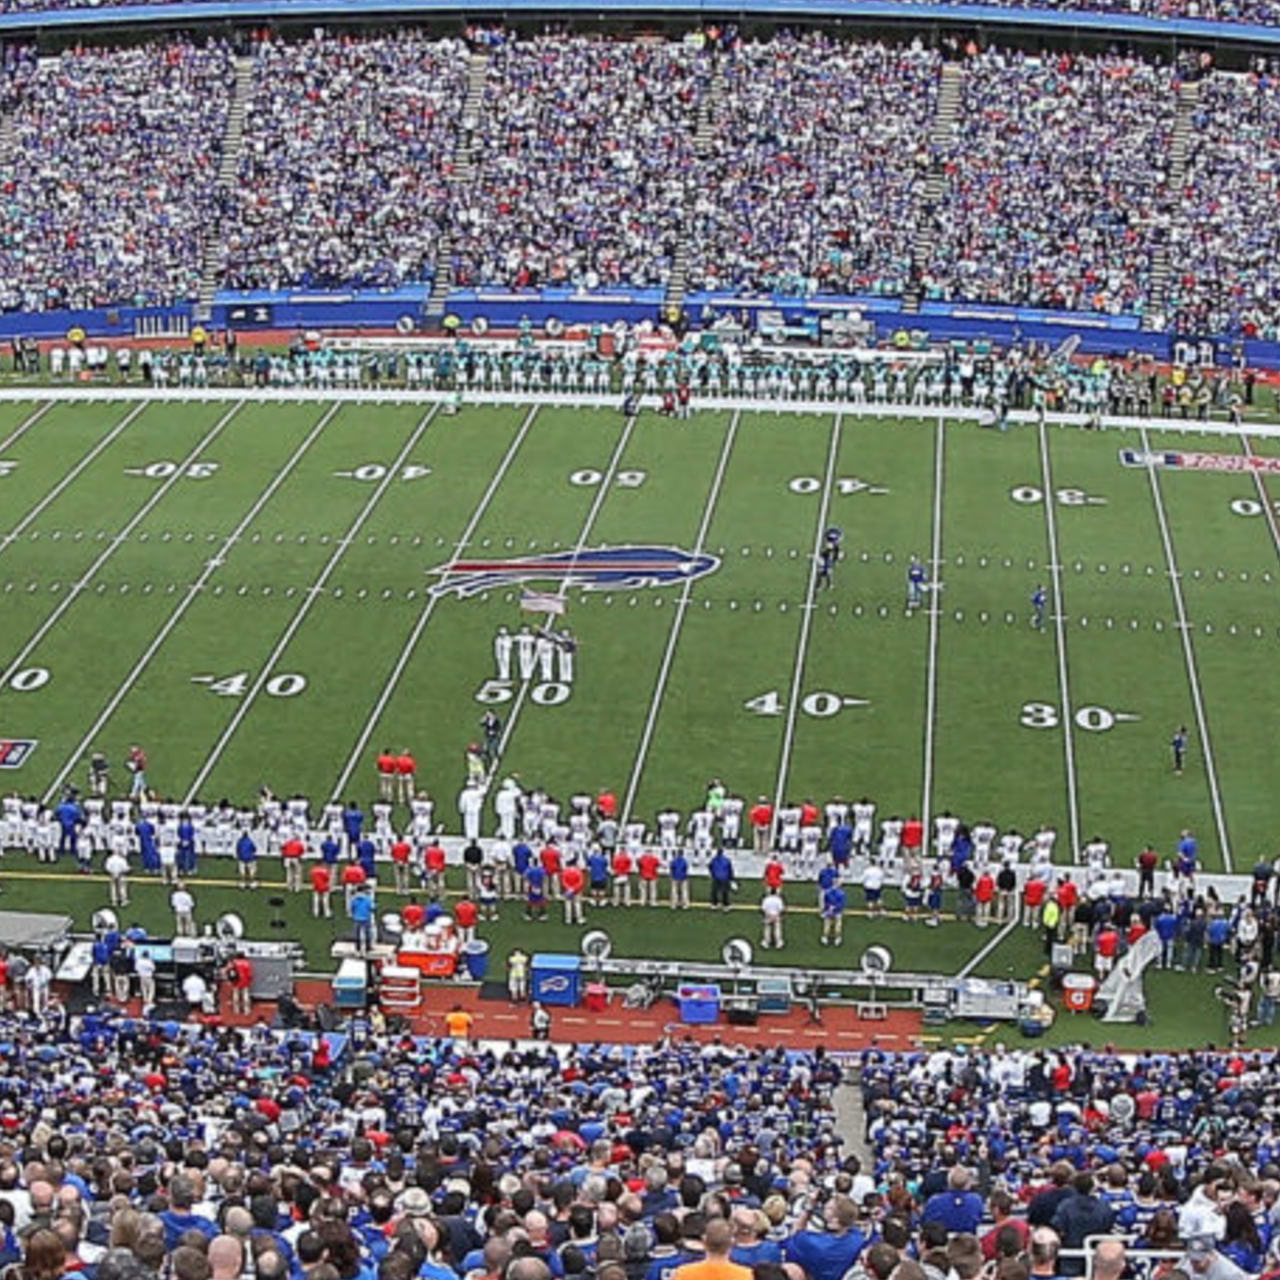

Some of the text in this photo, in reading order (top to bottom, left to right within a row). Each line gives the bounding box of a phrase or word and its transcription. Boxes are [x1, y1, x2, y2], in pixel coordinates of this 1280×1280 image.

[569, 469, 647, 487] 50
[788, 476, 869, 496] 40
[1011, 487, 1088, 505] 30
[209, 672, 307, 698] 40
[474, 679, 573, 707] 50
[743, 690, 845, 717] 40
[1021, 702, 1116, 733] 30
